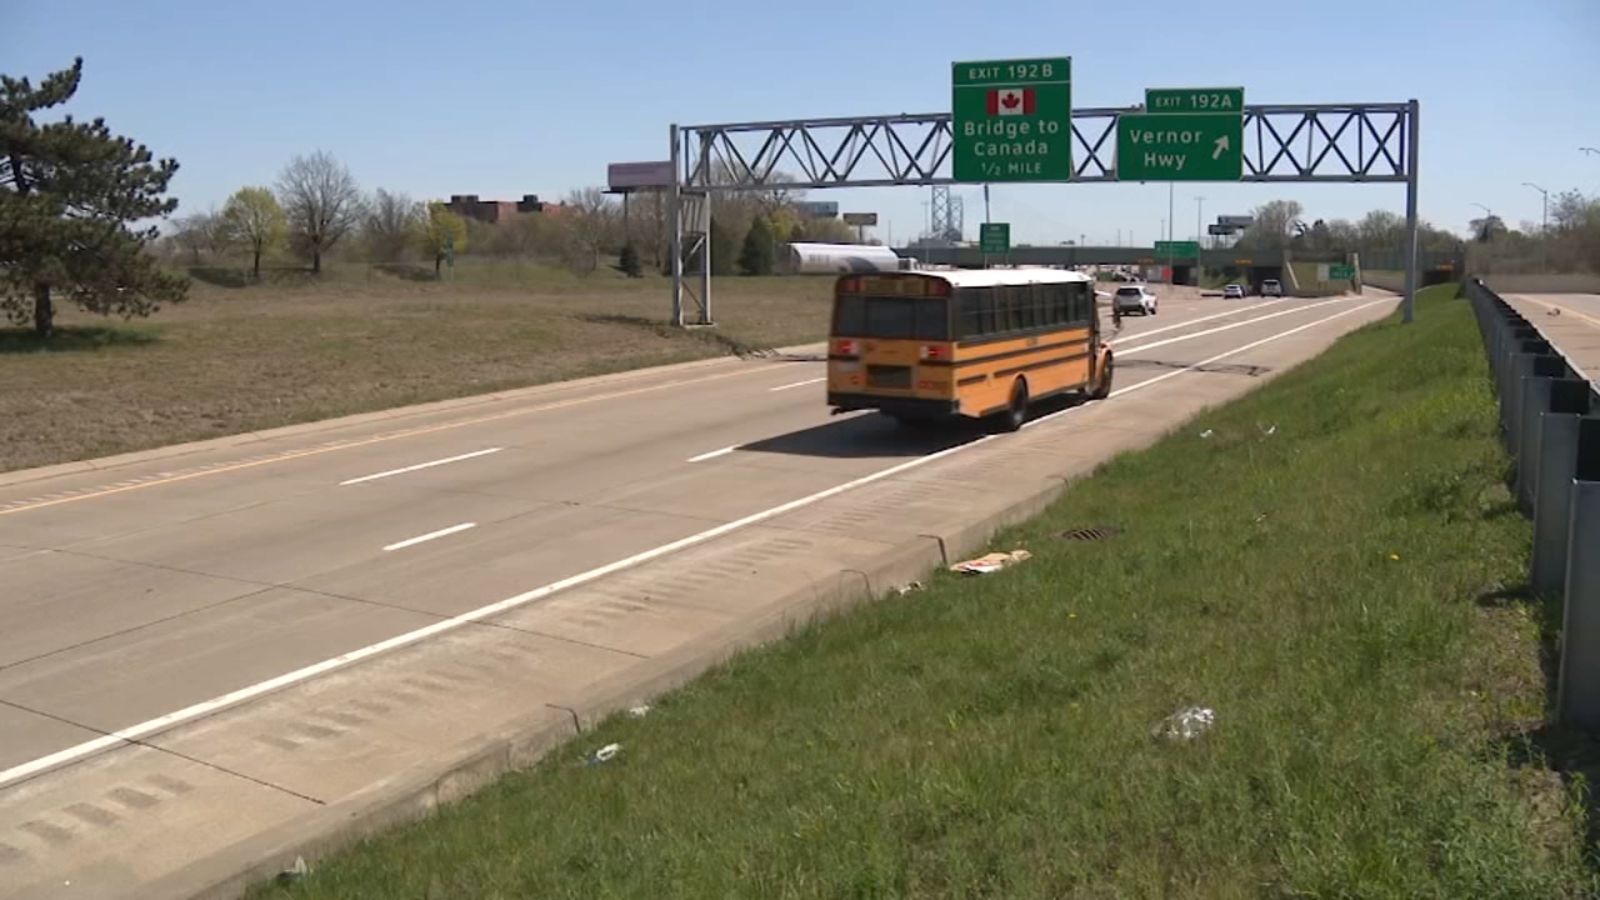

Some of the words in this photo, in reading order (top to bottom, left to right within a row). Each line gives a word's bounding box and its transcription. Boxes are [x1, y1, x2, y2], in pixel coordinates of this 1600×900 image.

[968, 67, 1000, 80] EXIT
[1155, 96, 1182, 108] EXIT
[1191, 93, 1233, 108] 192A
[963, 119, 1030, 138] Bridge
[1038, 119, 1059, 134] to
[1131, 129, 1202, 144] Vernor
[974, 139, 1048, 156] Canada
[1008, 162, 1041, 174] MILE
[1144, 152, 1186, 170] Hwy
